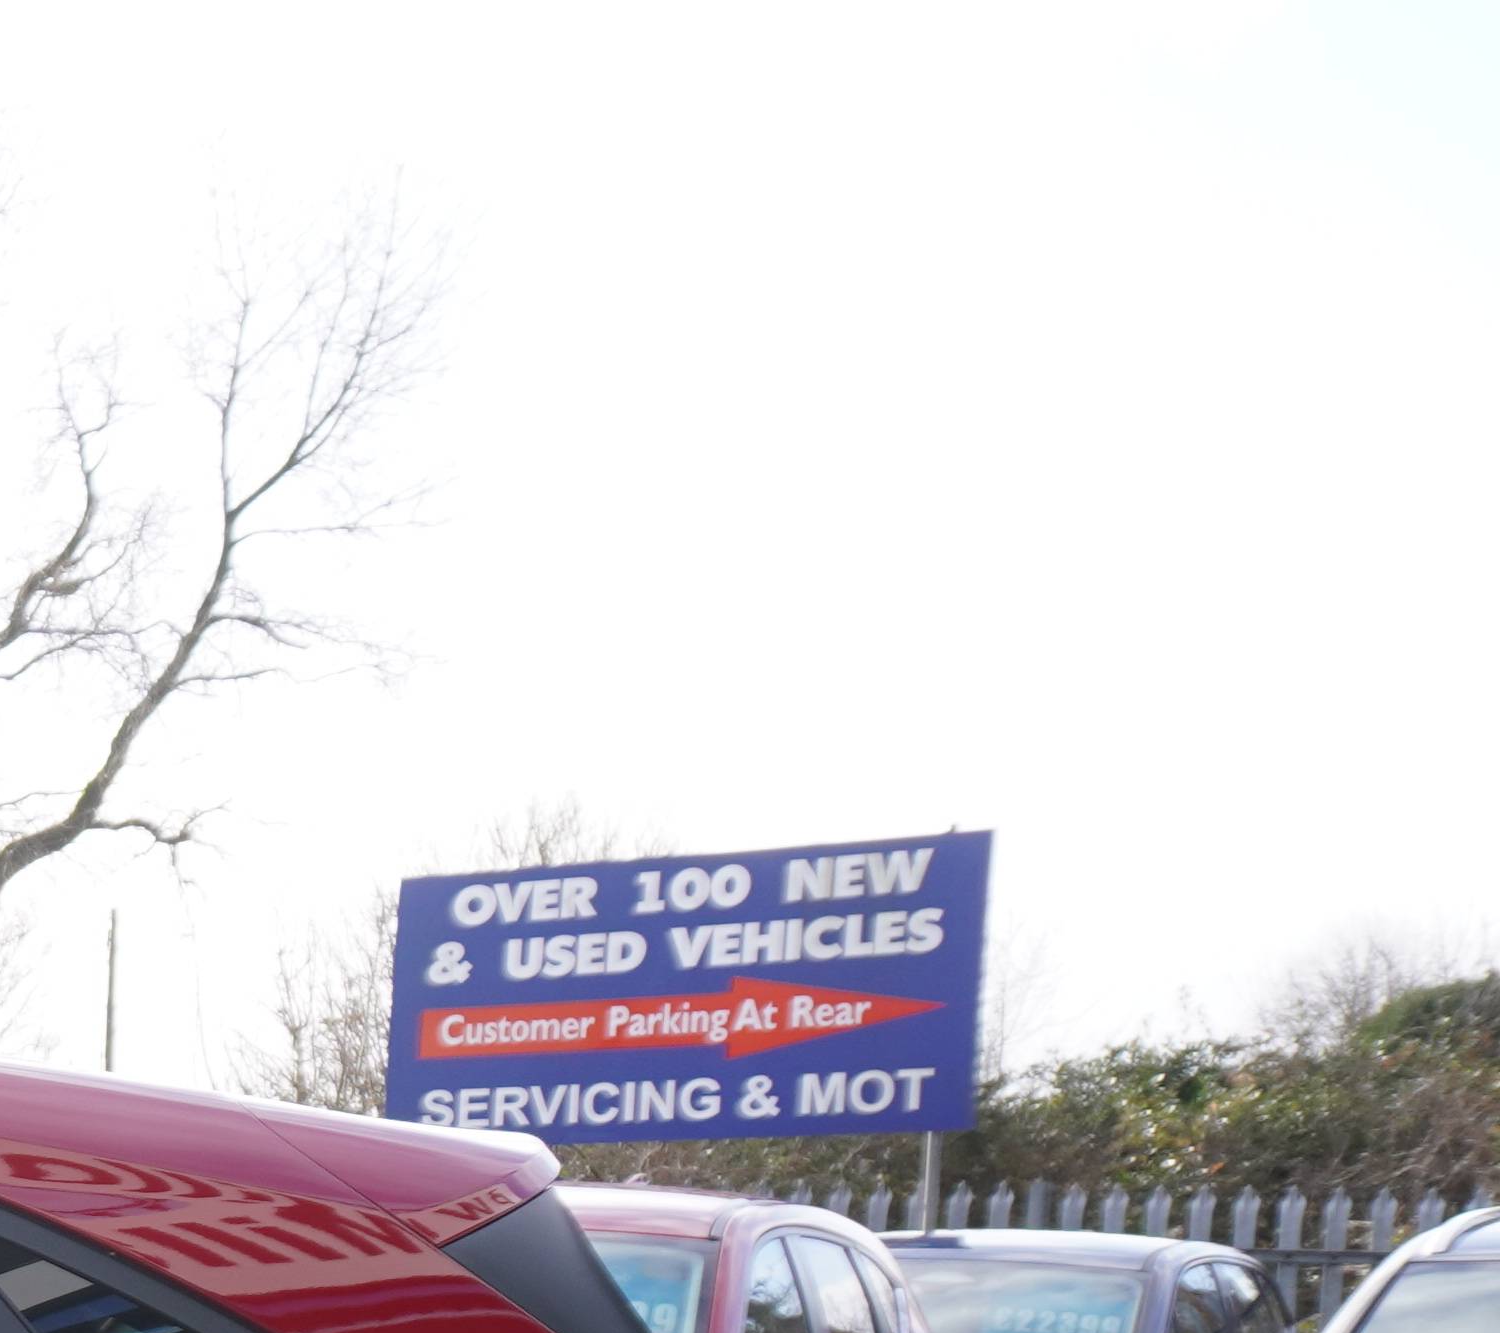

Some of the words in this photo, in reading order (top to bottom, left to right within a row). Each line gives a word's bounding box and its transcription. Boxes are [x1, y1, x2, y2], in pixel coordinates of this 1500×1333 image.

[452, 876, 598, 928] OVER
[632, 863, 752, 915] 100
[784, 847, 934, 903] NEW
[425, 941, 474, 985] &
[504, 930, 648, 981] USED
[668, 906, 945, 969] VEHICLES
[438, 1014, 596, 1046] Customer
[605, 1001, 730, 1042] Parking
[731, 998, 778, 1031] At
[788, 995, 872, 1028] Rear
[419, 1077, 722, 1129] SERVICING
[736, 1074, 781, 1118] &
[796, 1067, 937, 1116] MOT
